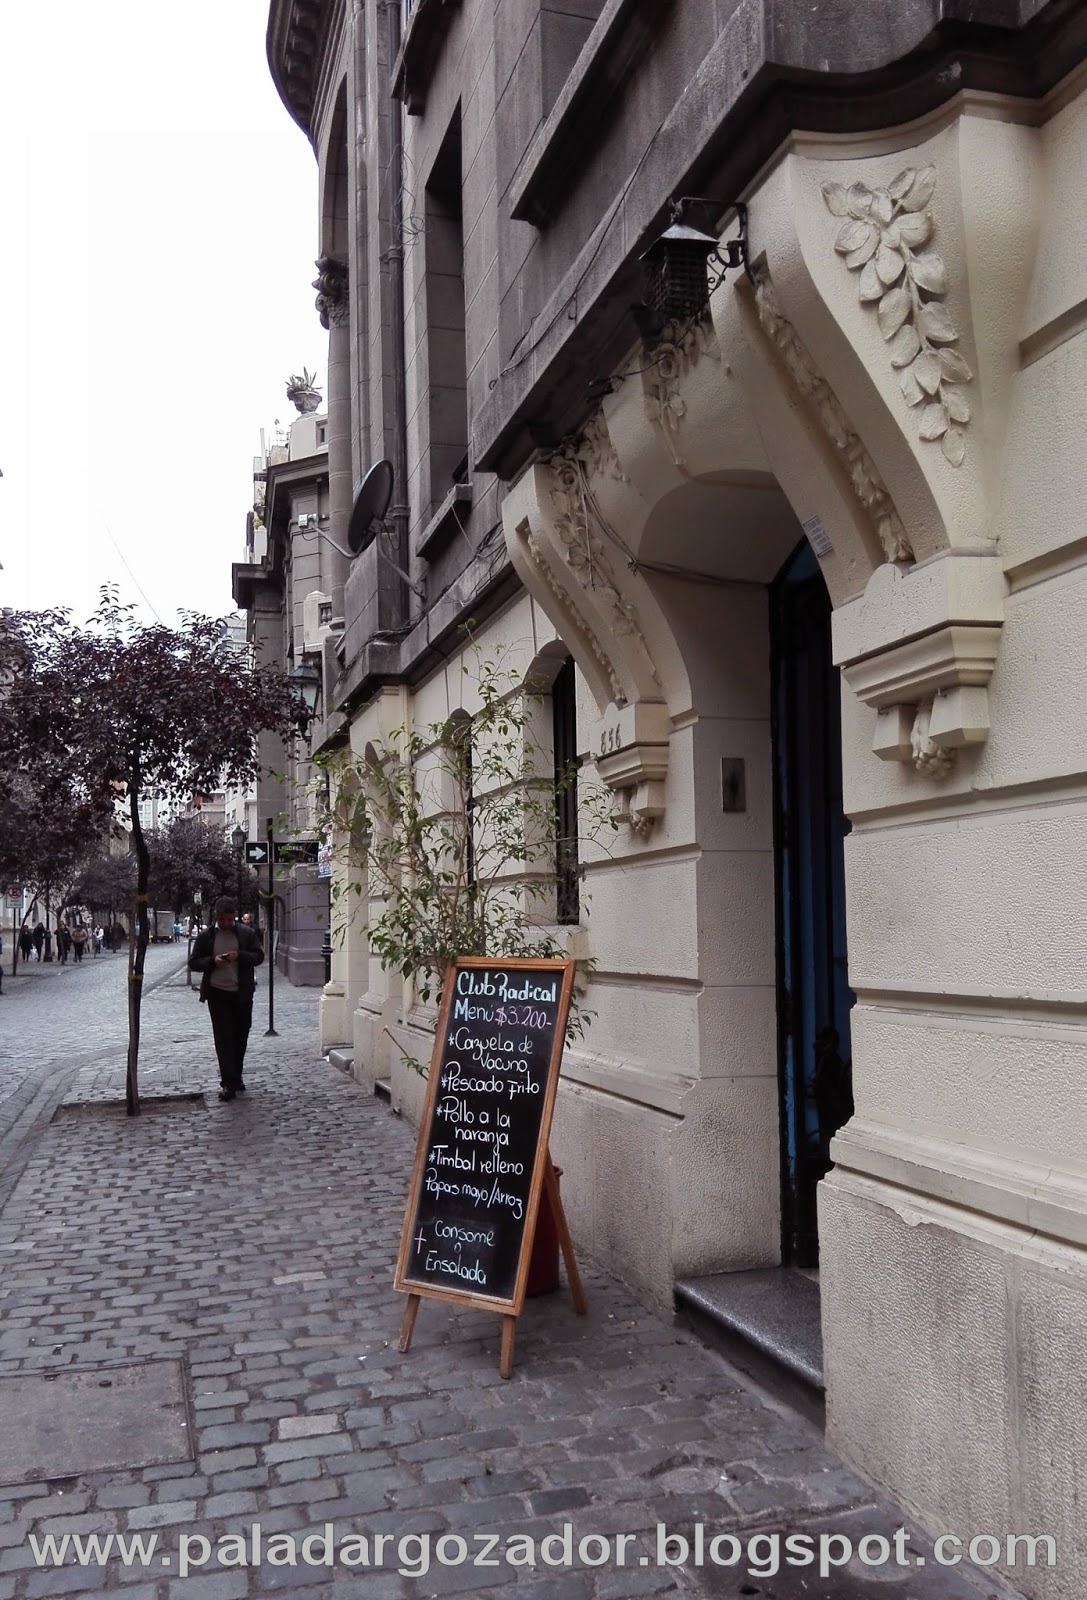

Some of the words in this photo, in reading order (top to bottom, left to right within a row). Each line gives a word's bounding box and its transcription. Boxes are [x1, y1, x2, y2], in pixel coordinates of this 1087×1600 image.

[600, 723, 621, 755] 856
[457, 972, 495, 996] Club
[494, 973, 556, 1002] Radical
[518, 1035, 533, 1054] de
[480, 1056, 528, 1073] Vacuno
[478, 1111, 489, 1124] a
[496, 1107, 511, 1128] la
[455, 1126, 510, 1156] naranja
[480, 1153, 524, 1175] relleno
[425, 1167, 460, 1200] Papas
[434, 1220, 496, 1247] Consome
[425, 1250, 487, 1285] Ensalada
